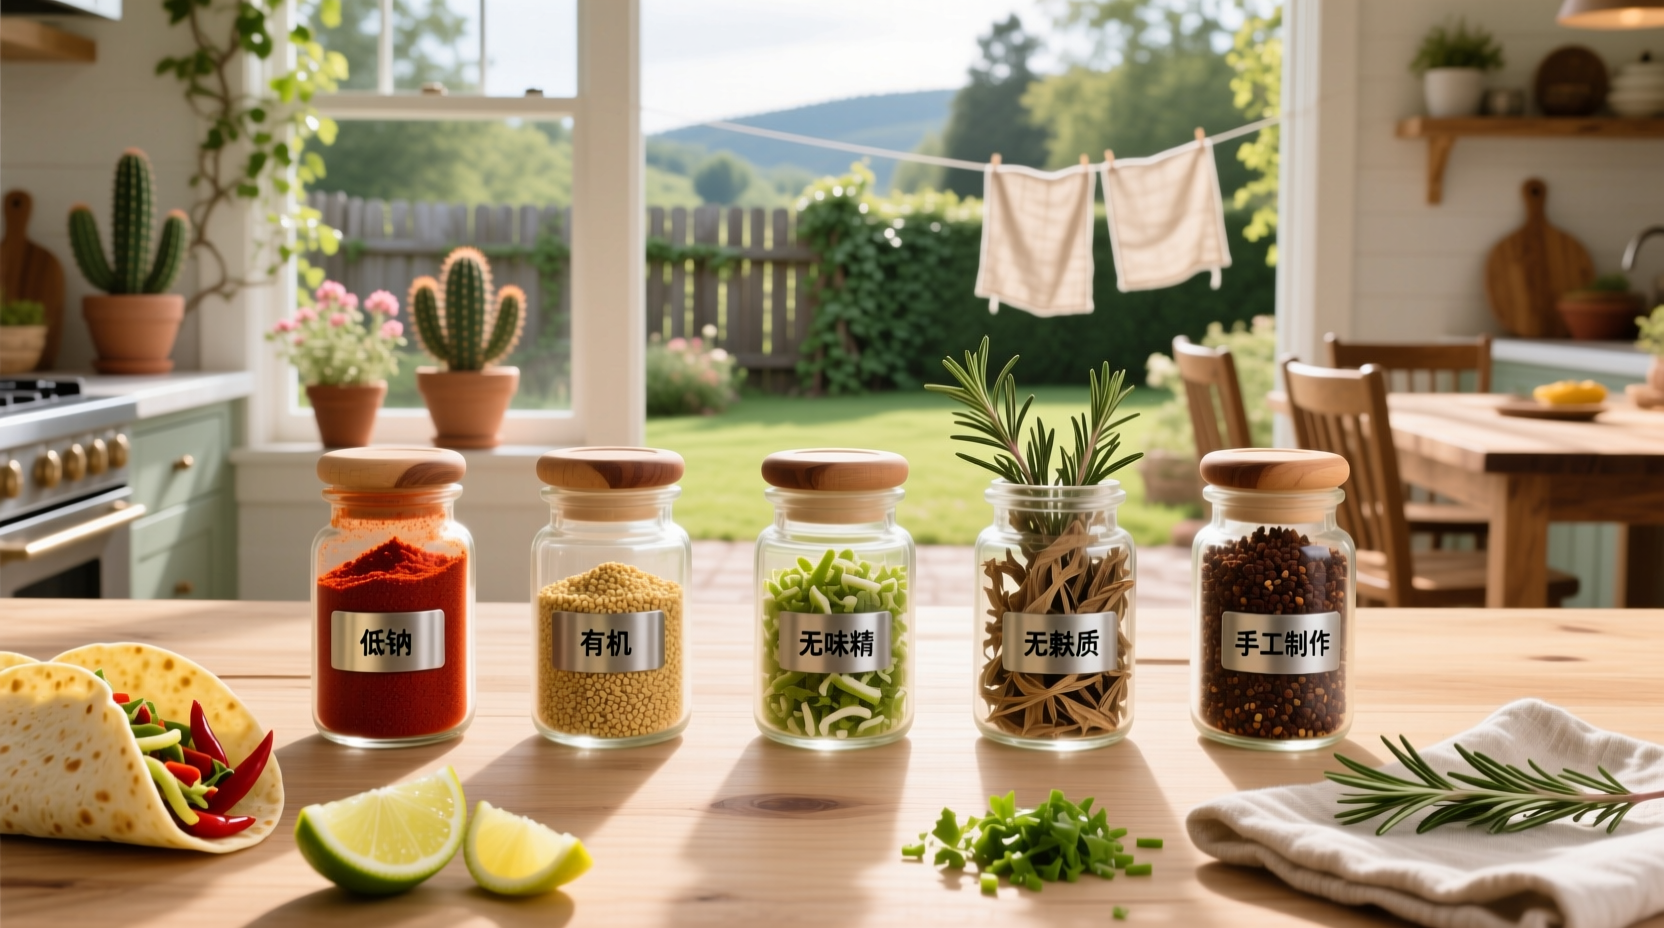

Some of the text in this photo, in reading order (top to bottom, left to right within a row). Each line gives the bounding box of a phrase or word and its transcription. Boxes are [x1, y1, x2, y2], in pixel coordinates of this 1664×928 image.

[360, 628, 412, 657] 低钠
[580, 628, 632, 657] 有机
[799, 629, 874, 658] 无味精
[1234, 629, 1331, 658] 手工制作
